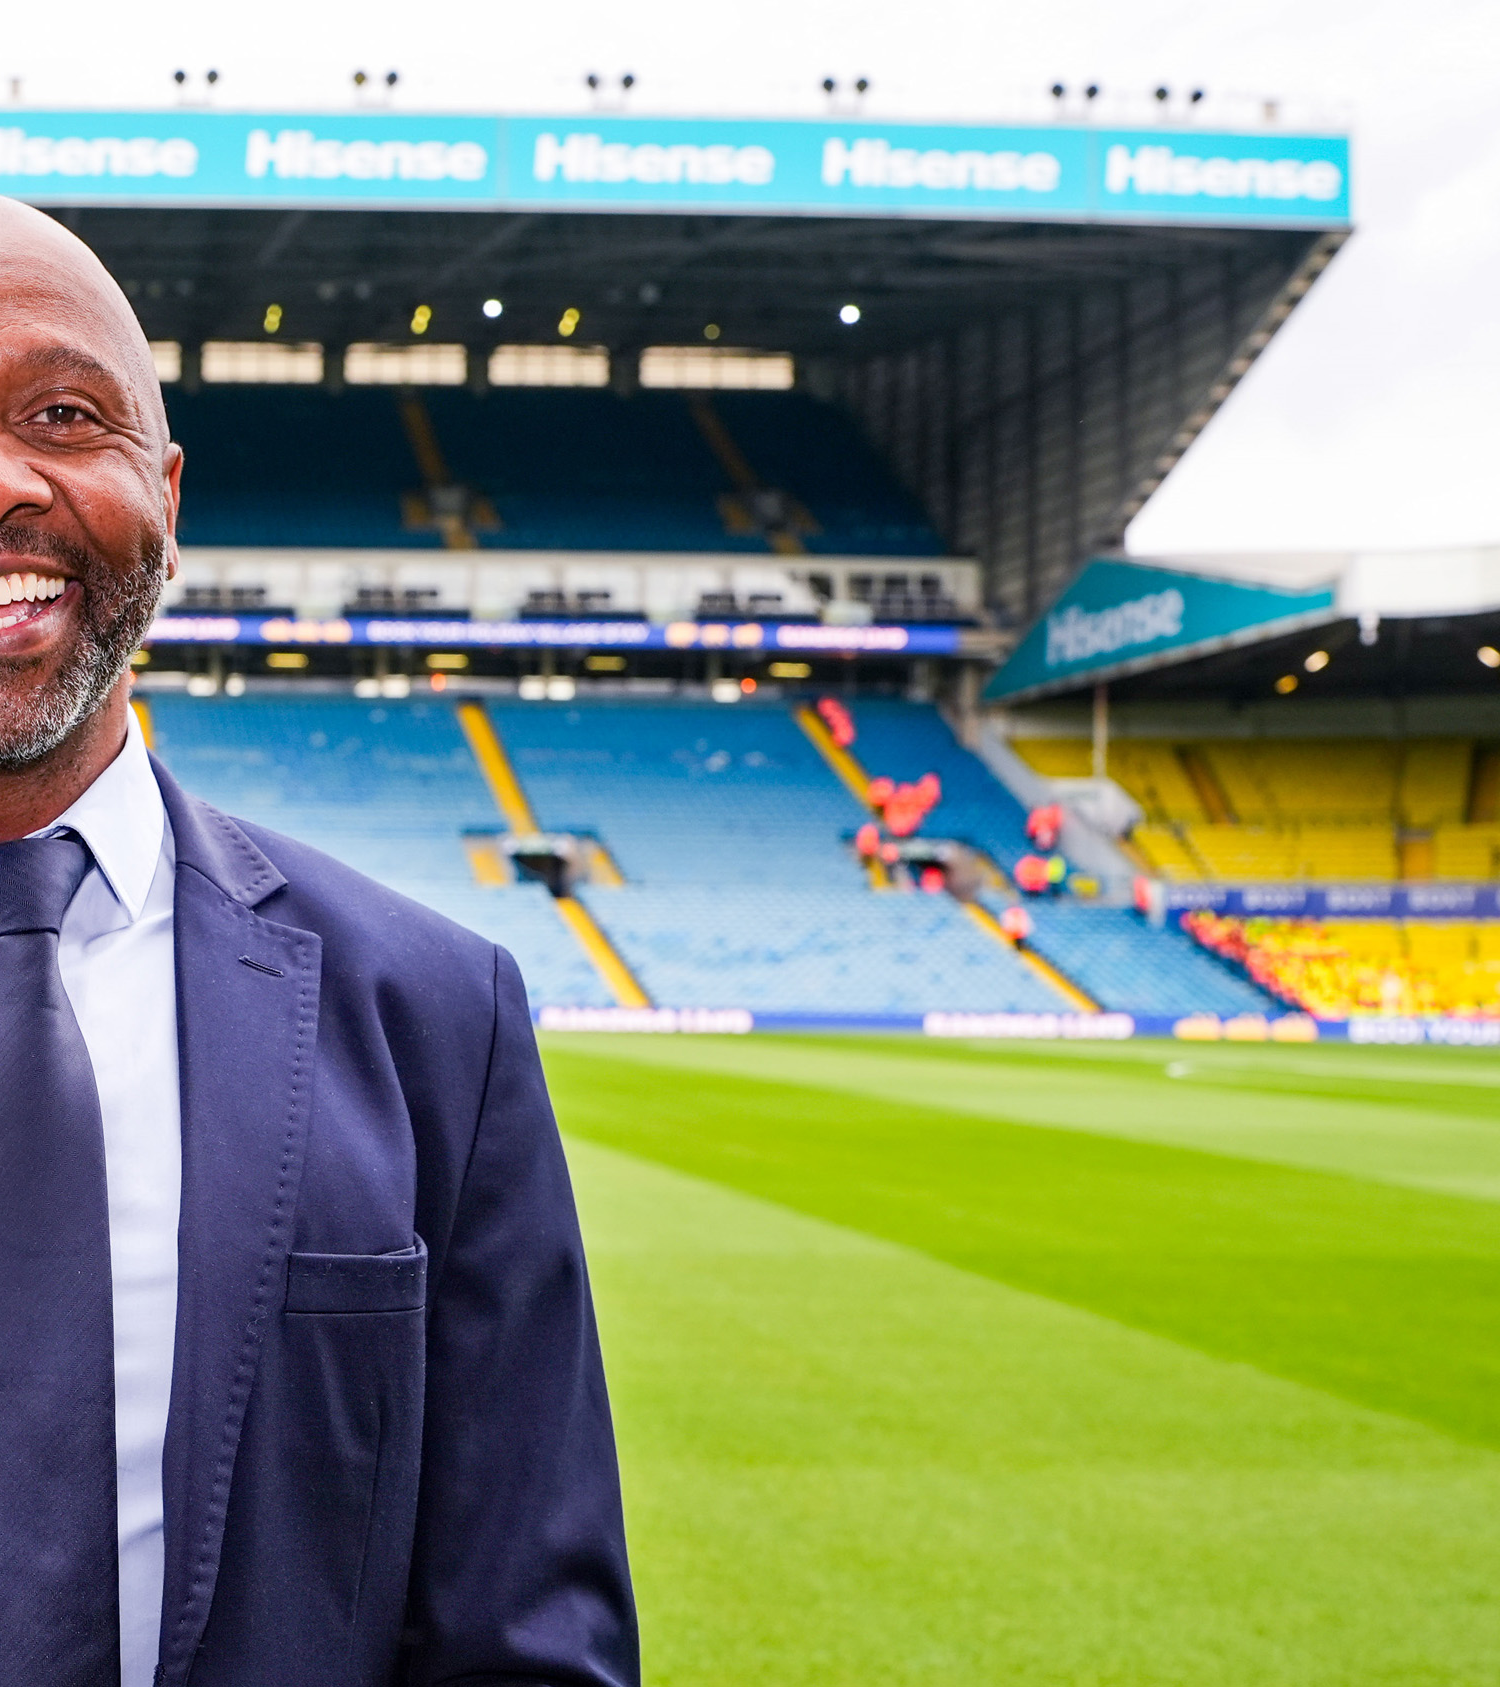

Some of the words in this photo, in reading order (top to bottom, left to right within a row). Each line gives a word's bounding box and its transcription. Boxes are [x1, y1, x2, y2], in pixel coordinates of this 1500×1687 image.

[246, 130, 487, 182] Hisense
[534, 134, 774, 185] Hisense
[822, 138, 1060, 192] Hisense
[1106, 146, 1340, 201] Hisense
[1045, 588, 1184, 667] Hisense
